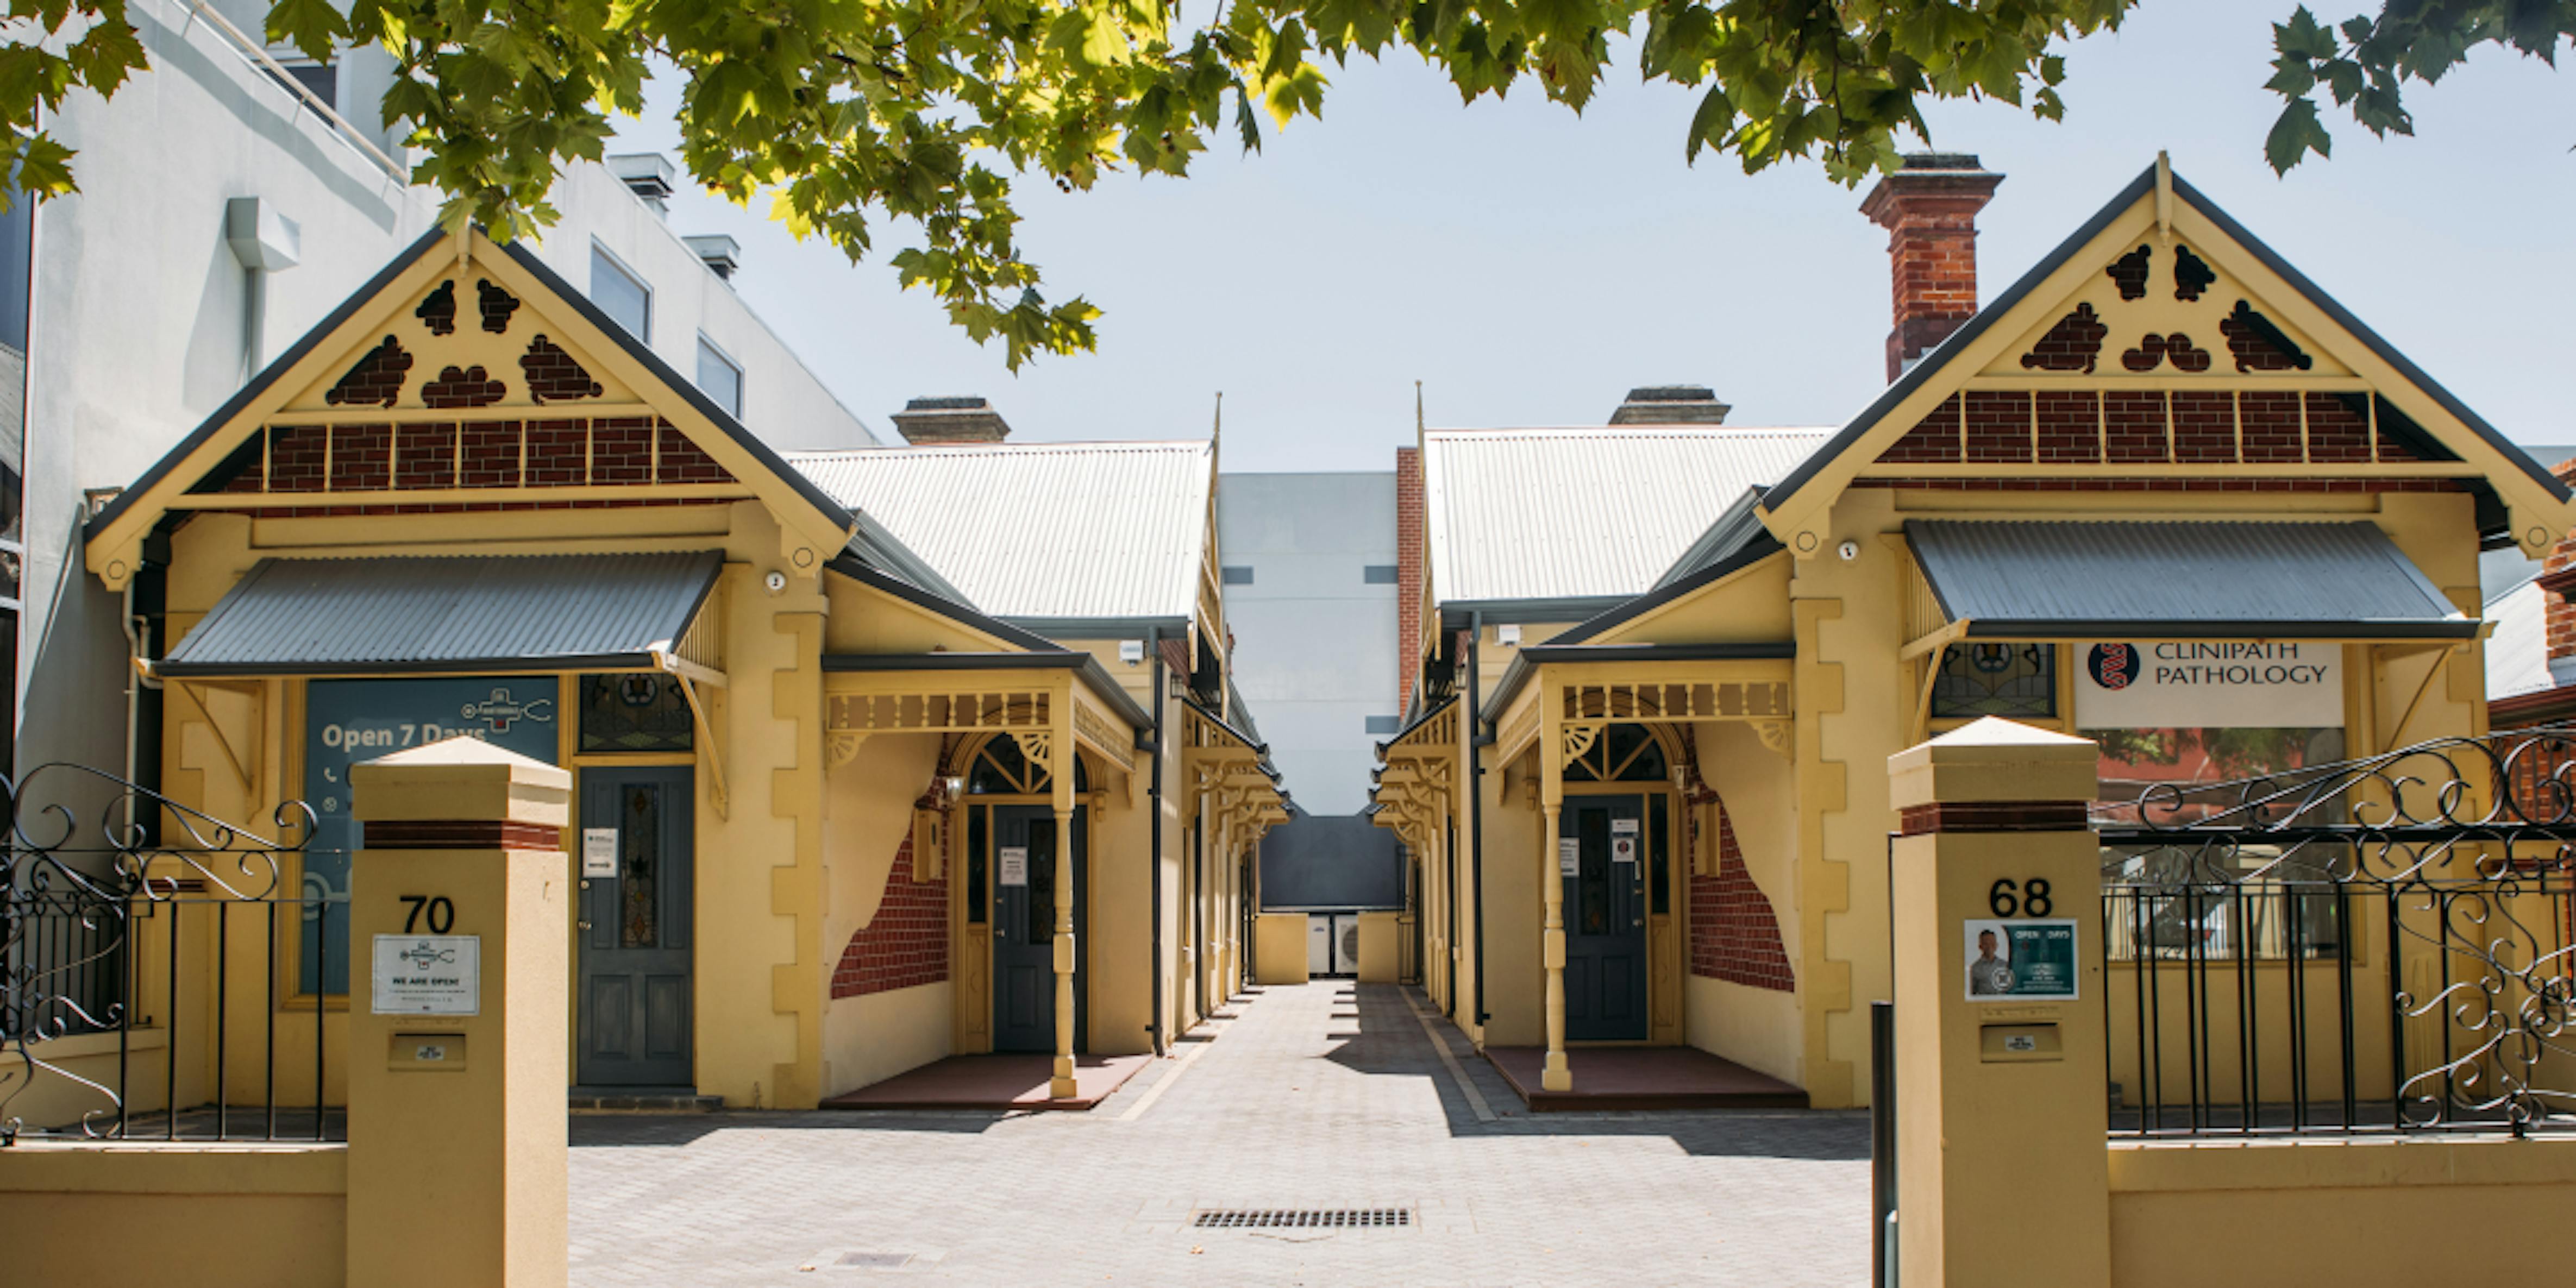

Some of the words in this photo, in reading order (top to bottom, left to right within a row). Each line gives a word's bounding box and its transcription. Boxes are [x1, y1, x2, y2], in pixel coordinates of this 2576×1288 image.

[2155, 643, 2297, 659] CLINIPATH
[2156, 665, 2327, 683] PATHOLOGY
[322, 724, 393, 753] Open
[399, 724, 416, 746] 7
[1989, 877, 2053, 918] 68
[399, 895, 454, 934] 70
[393, 977, 406, 985] WE
[409, 977, 428, 985] ARE
